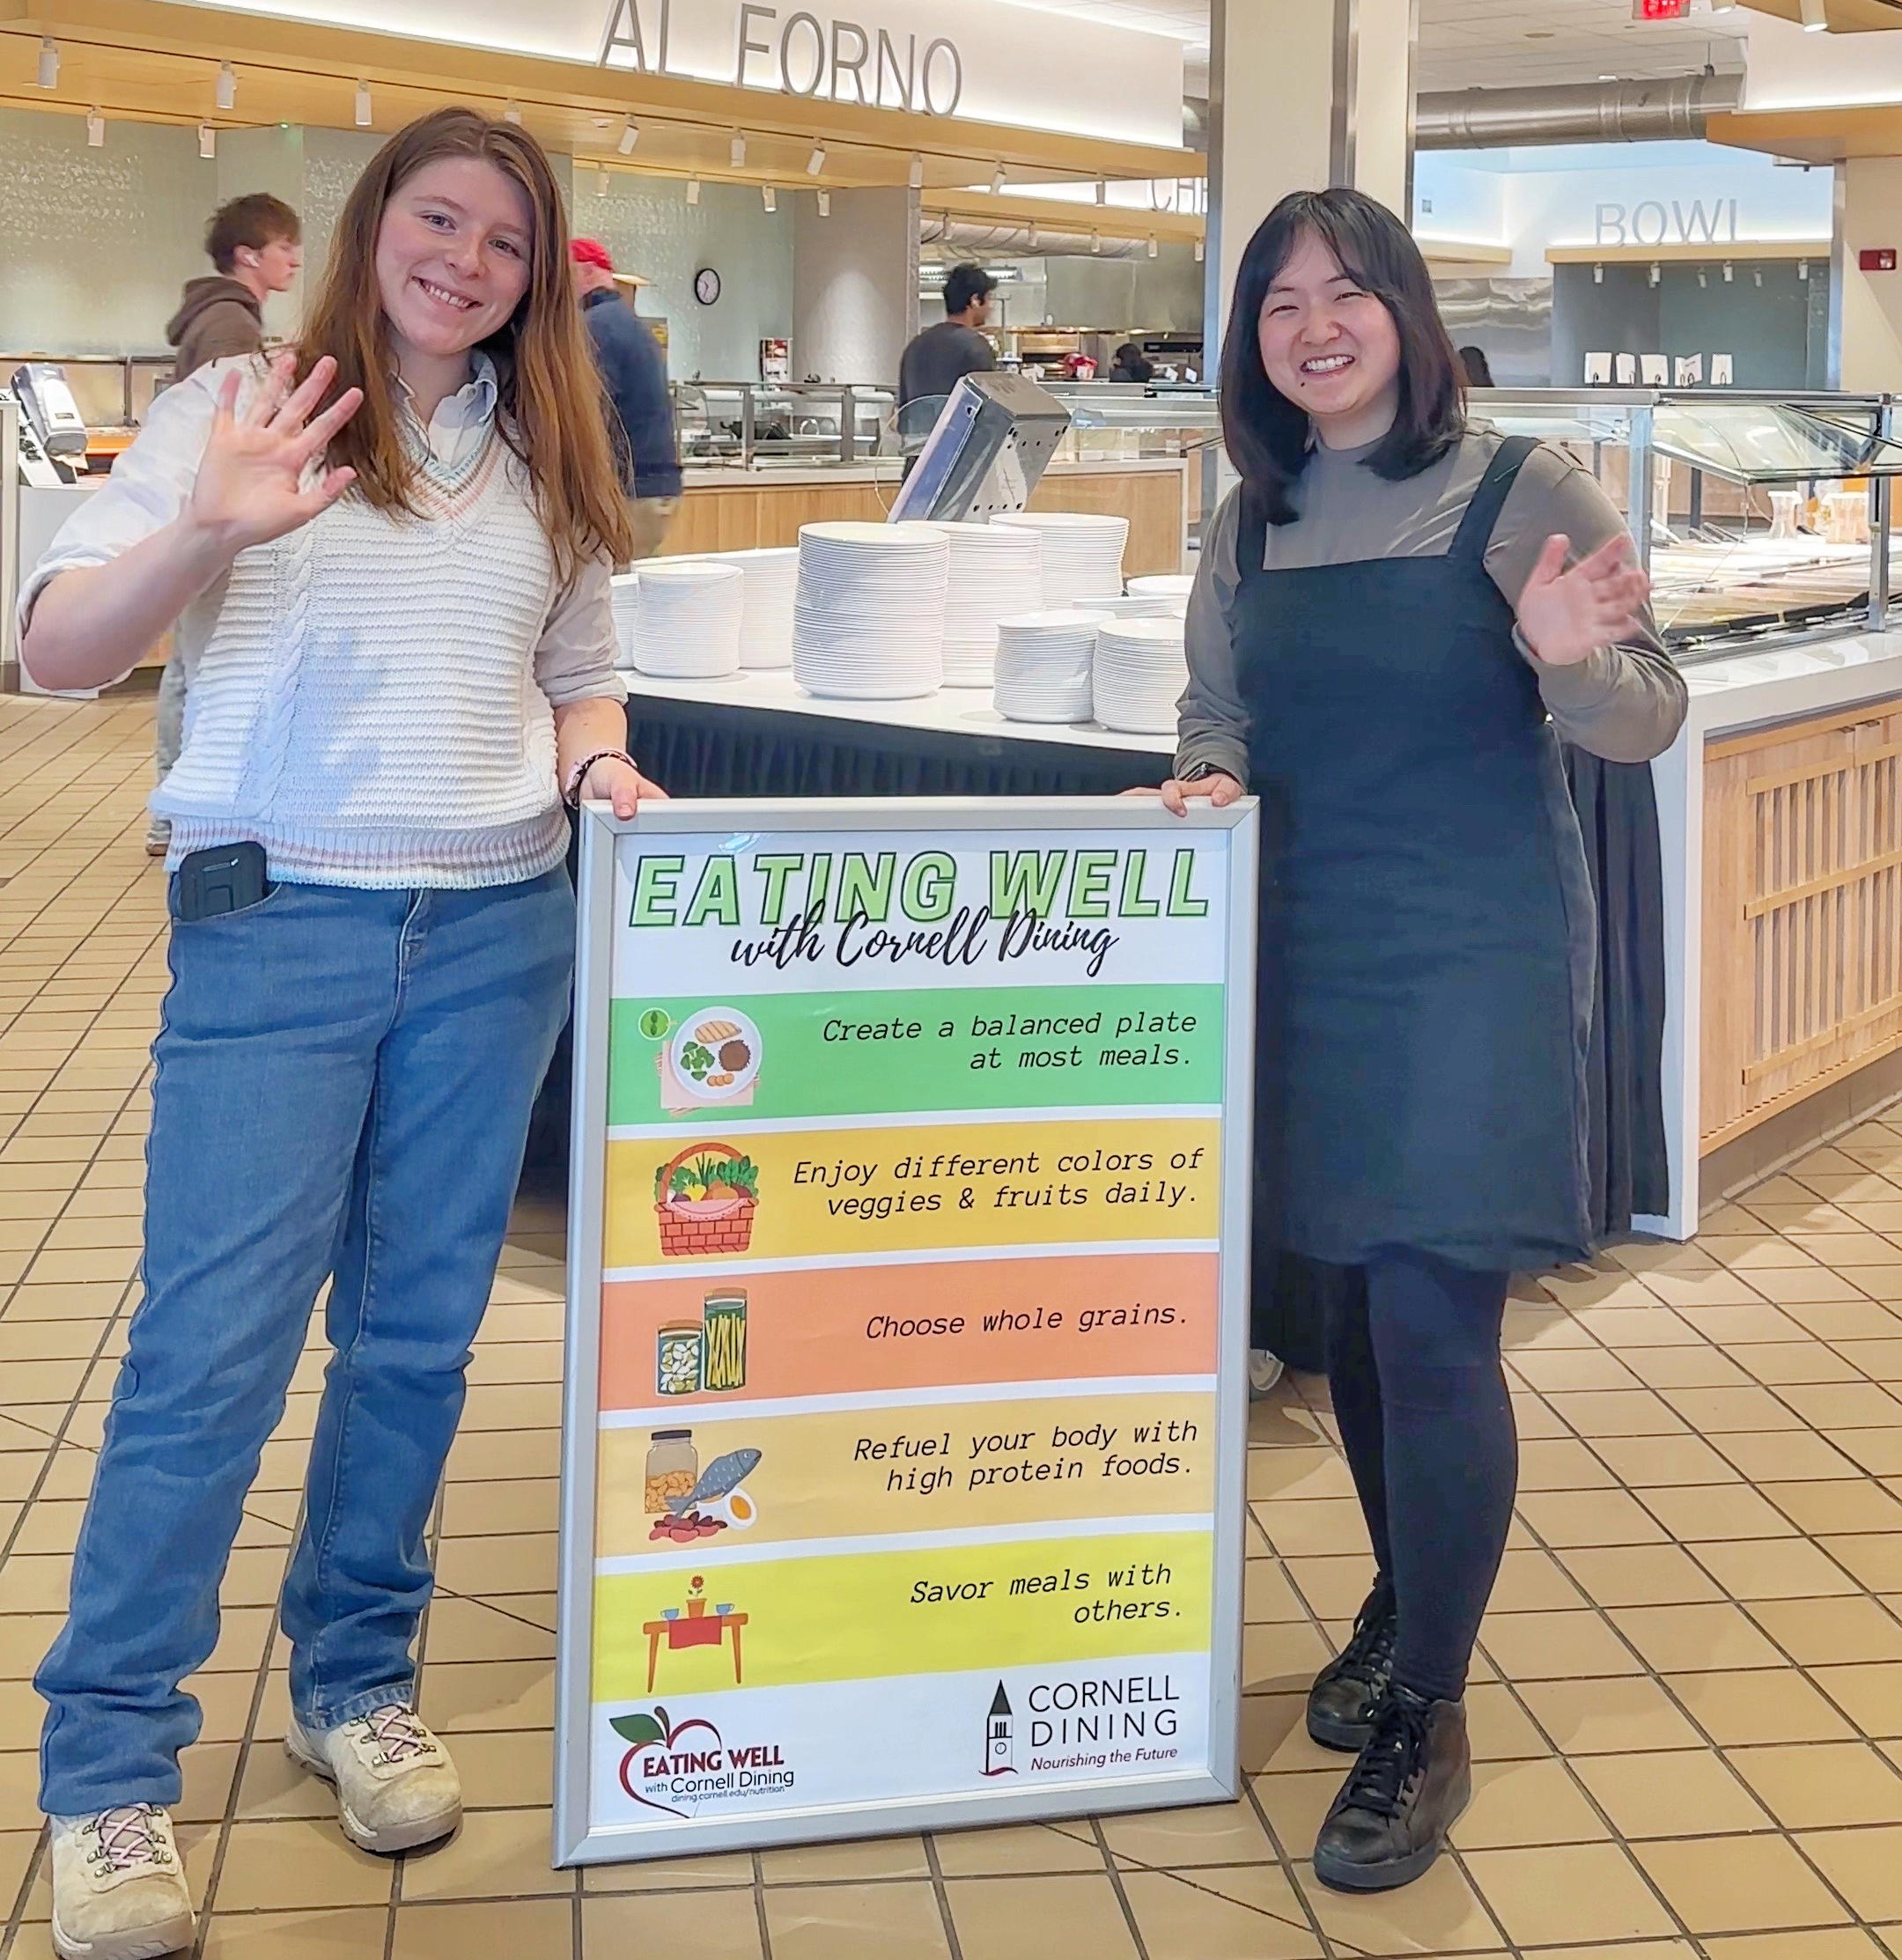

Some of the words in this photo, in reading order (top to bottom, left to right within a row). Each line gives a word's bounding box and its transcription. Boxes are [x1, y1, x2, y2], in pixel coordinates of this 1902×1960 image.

[734, 3, 962, 115] FORNO
[629, 850, 958, 927] EATING
[989, 848, 1209, 920] WELL
[731, 898, 826, 970] with
[836, 904, 990, 968] Cornell
[998, 907, 1120, 978] Dining
[824, 1017, 923, 1042] Create
[939, 1021, 955, 1038] a
[971, 1012, 1103, 1037] balanced
[1116, 1011, 1198, 1039] plate
[970, 1047, 1003, 1070] at
[1019, 1045, 1084, 1068] most
[1099, 1043, 1191, 1066] meals.
[794, 1159, 880, 1189] Enjoy
[895, 1152, 1041, 1179] different
[1058, 1149, 1154, 1173] colors
[1171, 1147, 1206, 1169] of
[829, 1190, 943, 1220] veggies
[959, 1187, 976, 1210] &
[994, 1183, 1089, 1208] fruits
[1106, 1180, 1196, 1208] daily.
[867, 1315, 966, 1339] Choose
[984, 1307, 1064, 1332] whole
[1079, 1302, 1187, 1333] grains.
[854, 1433, 951, 1462] Refuel
[969, 1430, 1036, 1459] your
[1051, 1423, 1118, 1448] body
[1134, 1419, 1198, 1443] with
[888, 1465, 954, 1495] high
[969, 1457, 1084, 1491] protein
[1101, 1453, 1191, 1477] foods.
[910, 1581, 995, 1604] Savor
[1009, 1568, 1091, 1596] meals
[1109, 1563, 1172, 1588] with
[1074, 1598, 1182, 1624] others.
[1028, 1675, 1180, 1713] CORNELL
[1030, 1708, 1177, 1747] DINING
[644, 1750, 722, 1778] EATING
[727, 1745, 785, 1770] WELL
[1031, 1753, 1106, 1771] Nourishing
[1110, 1750, 1132, 1764] the
[1135, 1748, 1178, 1762] Future
[645, 1781, 668, 1794] with
[671, 1772, 734, 1794] Cornell
[740, 1770, 794, 1787] Dining
